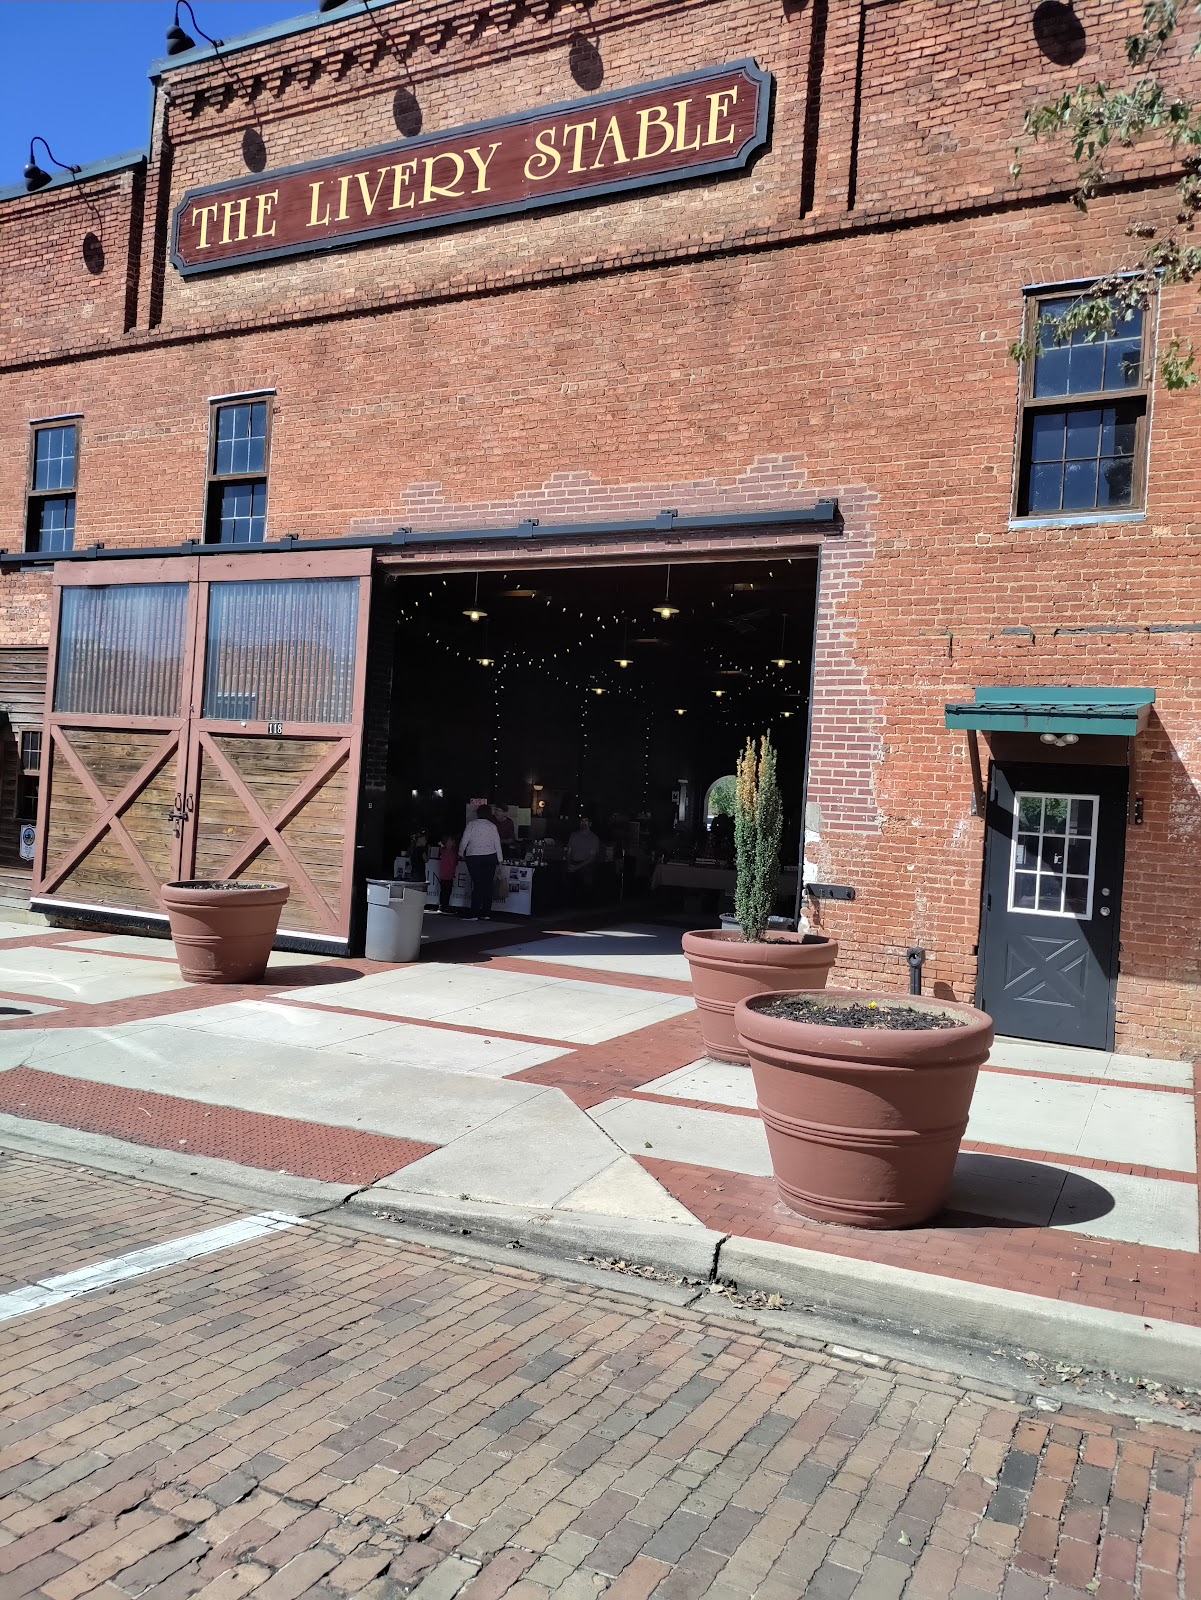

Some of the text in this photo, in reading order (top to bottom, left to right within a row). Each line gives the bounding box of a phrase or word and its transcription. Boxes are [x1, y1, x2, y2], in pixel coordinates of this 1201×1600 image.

[191, 84, 739, 251] THE LIVERY STABLE
[269, 723, 283, 734] 118
